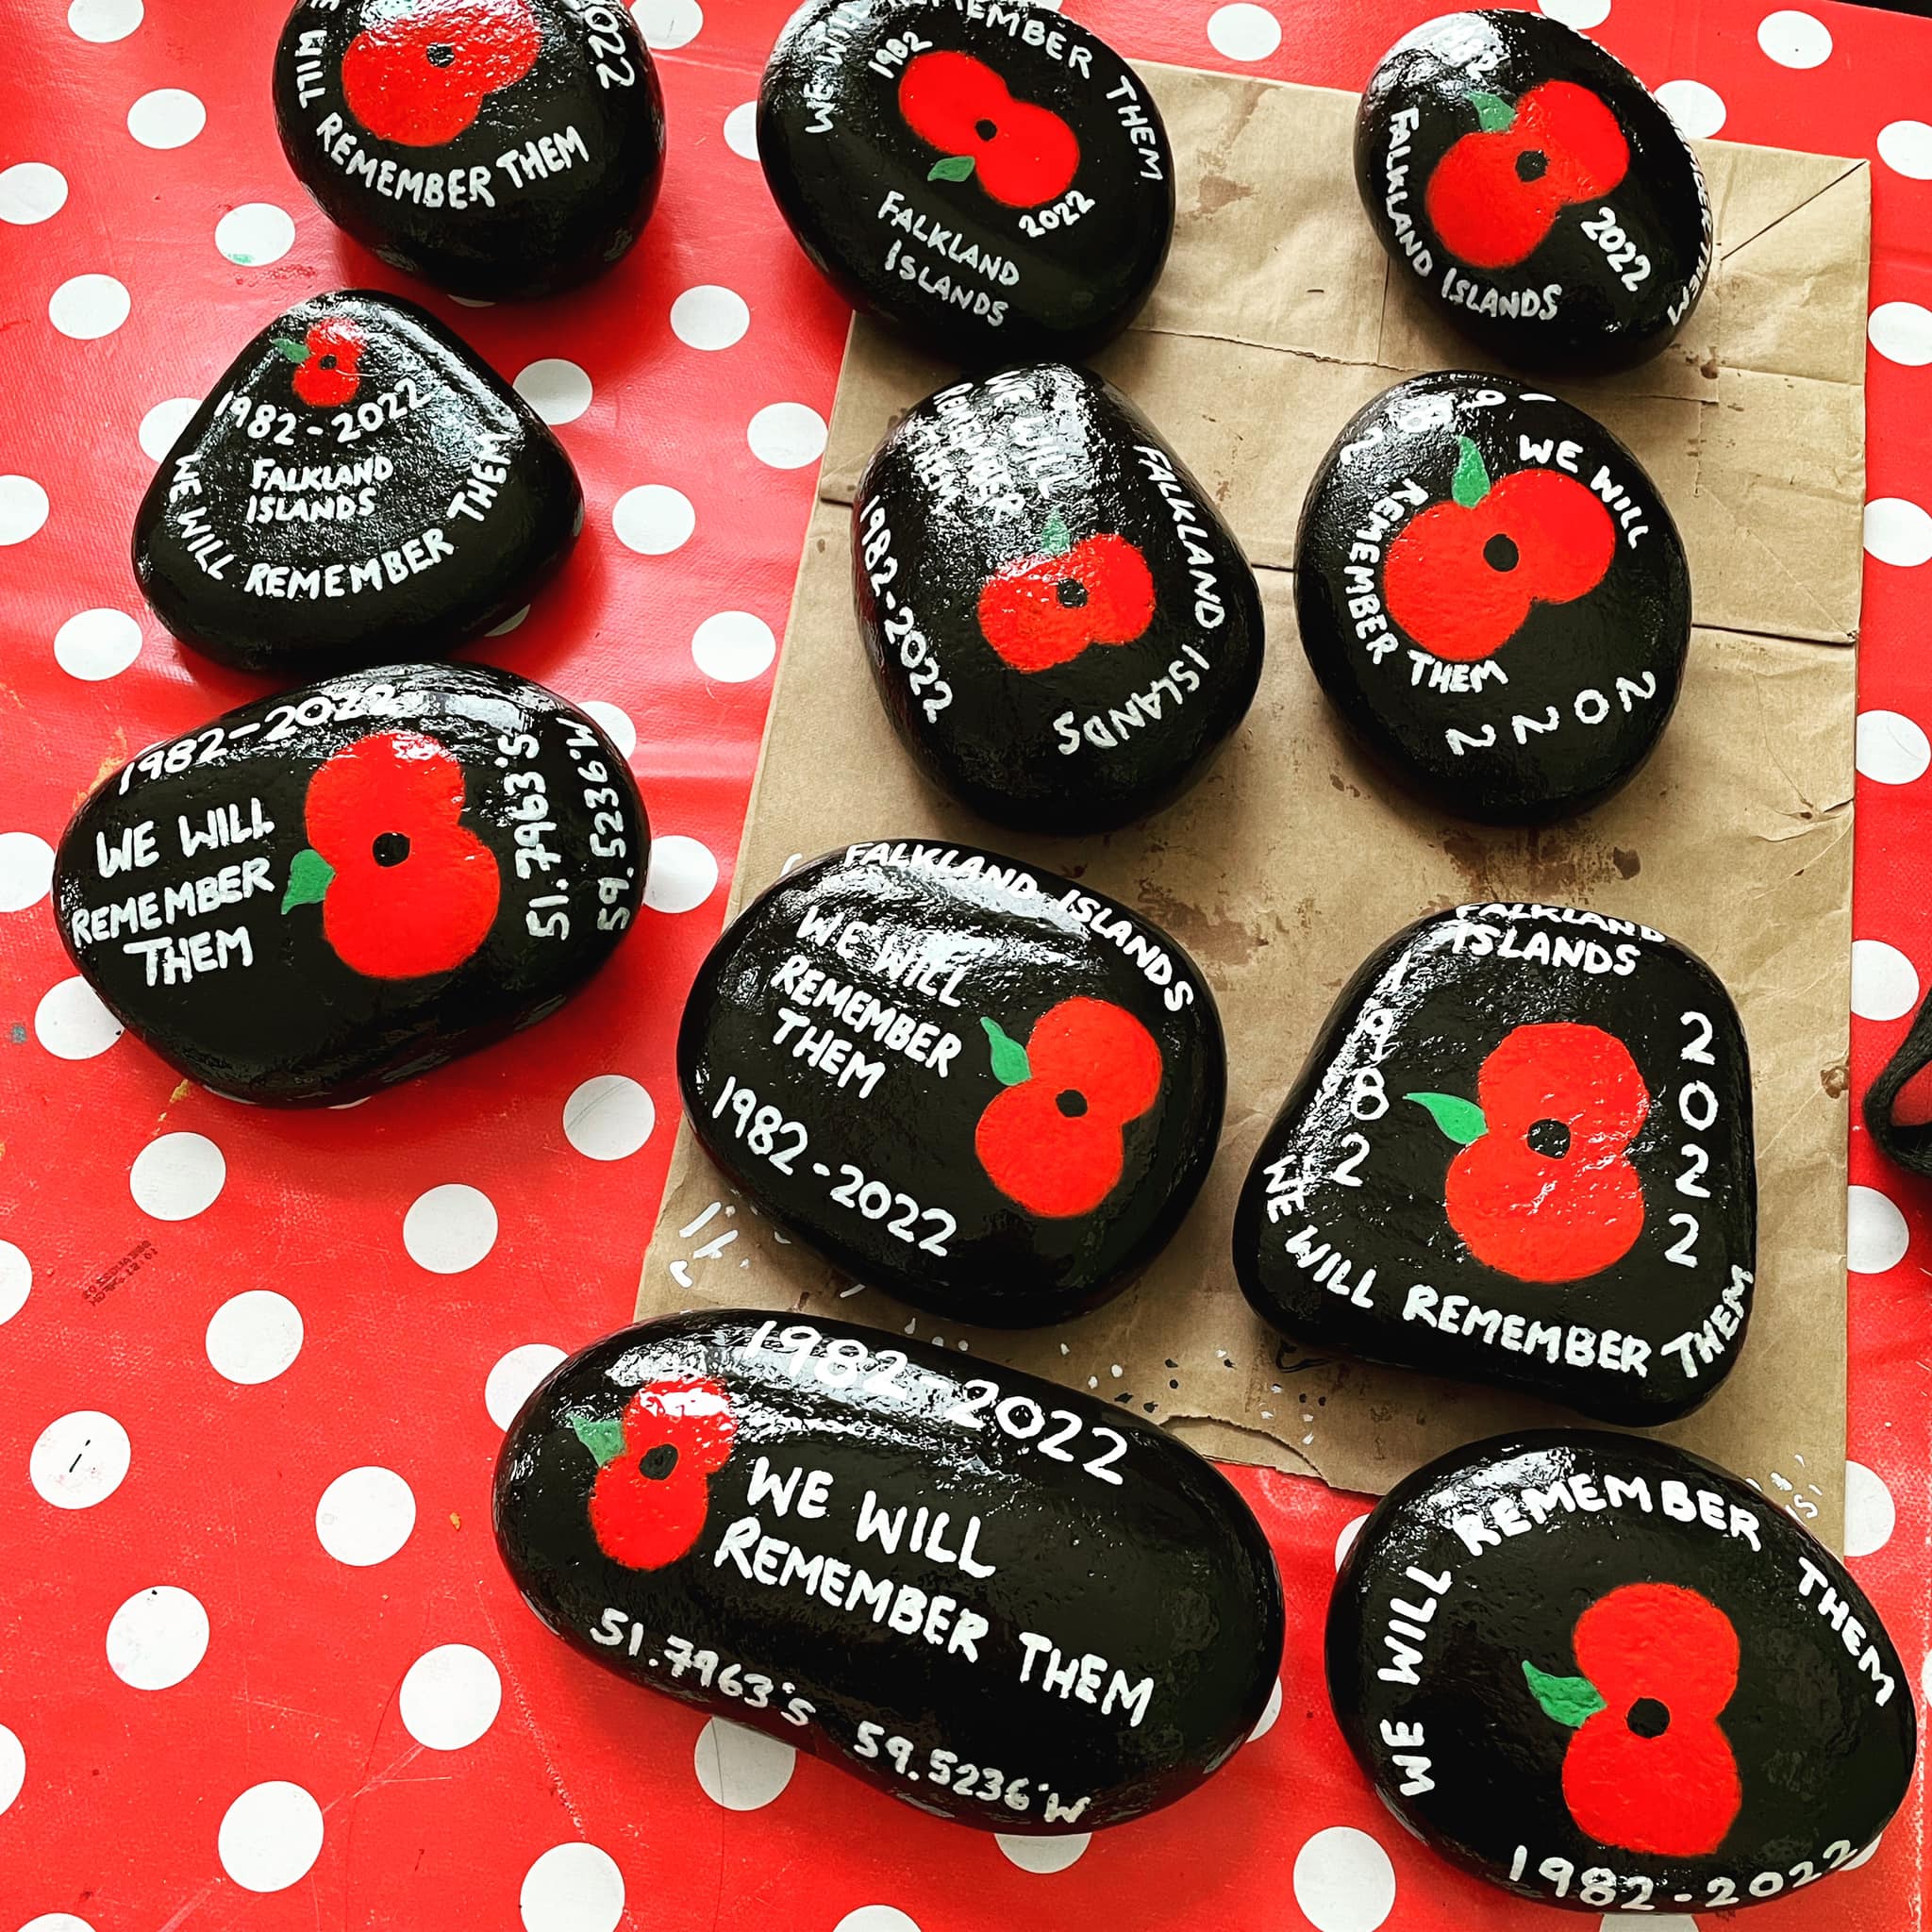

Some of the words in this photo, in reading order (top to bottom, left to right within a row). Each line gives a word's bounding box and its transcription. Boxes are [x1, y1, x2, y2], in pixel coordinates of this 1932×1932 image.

[583, 0, 635, 89] 022
[294, 30, 327, 108] WILL
[317, 112, 495, 208] REMEMBER
[496, 125, 589, 188] THEM
[804, 83, 834, 133] WE
[1106, 75, 1163, 180] THEM
[878, 191, 1019, 285] FALKLAND
[1019, 190, 1095, 238] 2022
[1386, 108, 1433, 275] FALKLAND
[1441, 268, 1562, 321] ISLANDS
[1581, 207, 1652, 291] 2022
[885, 240, 1009, 326] ISLANDS
[170, 453, 203, 503] WE
[246, 489, 379, 524] ISLANDS
[250, 455, 393, 491] FALKLAND
[446, 432, 512, 522] THEM
[1519, 435, 1583, 473] WE
[1590, 465, 1649, 549] WILL
[178, 506, 236, 581] WILL
[244, 528, 455, 600] REMEMBER
[1134, 445, 1226, 628] FALKLAND
[1343, 479, 1429, 664] REMEMBER
[1407, 649, 1508, 693] THEM
[1053, 644, 1209, 755] ISLANDS
[96, 821, 158, 878] WE
[178, 798, 275, 858] WILL
[71, 857, 275, 948] REMEMBER
[843, 841, 1038, 899] FALKLAND
[1056, 890, 1194, 1012] ISLANDS
[1456, 903, 1666, 942] FALKLAND
[124, 926, 253, 987] THEM
[796, 906, 868, 959] WE
[873, 932, 968, 1007] WILL
[1452, 923, 1641, 976] ISLANDS
[771, 954, 962, 1077] REMEMBER
[772, 1008, 885, 1099] THEM
[1284, 1225, 1374, 1308] WILL
[1403, 1285, 1652, 1378] REMEMBER
[1660, 1265, 1756, 1378] THEM
[746, 1457, 835, 1519] WE
[855, 1490, 996, 1578] WILL
[1452, 1474, 1761, 1557] REMEMBER
[713, 1516, 990, 1663] REMEMBER
[1018, 1632, 1155, 1727] THEM
[1377, 1564, 1452, 1686] WILL
[1797, 1557, 1895, 1707] THEM
[1380, 1719, 1435, 1797] WE
